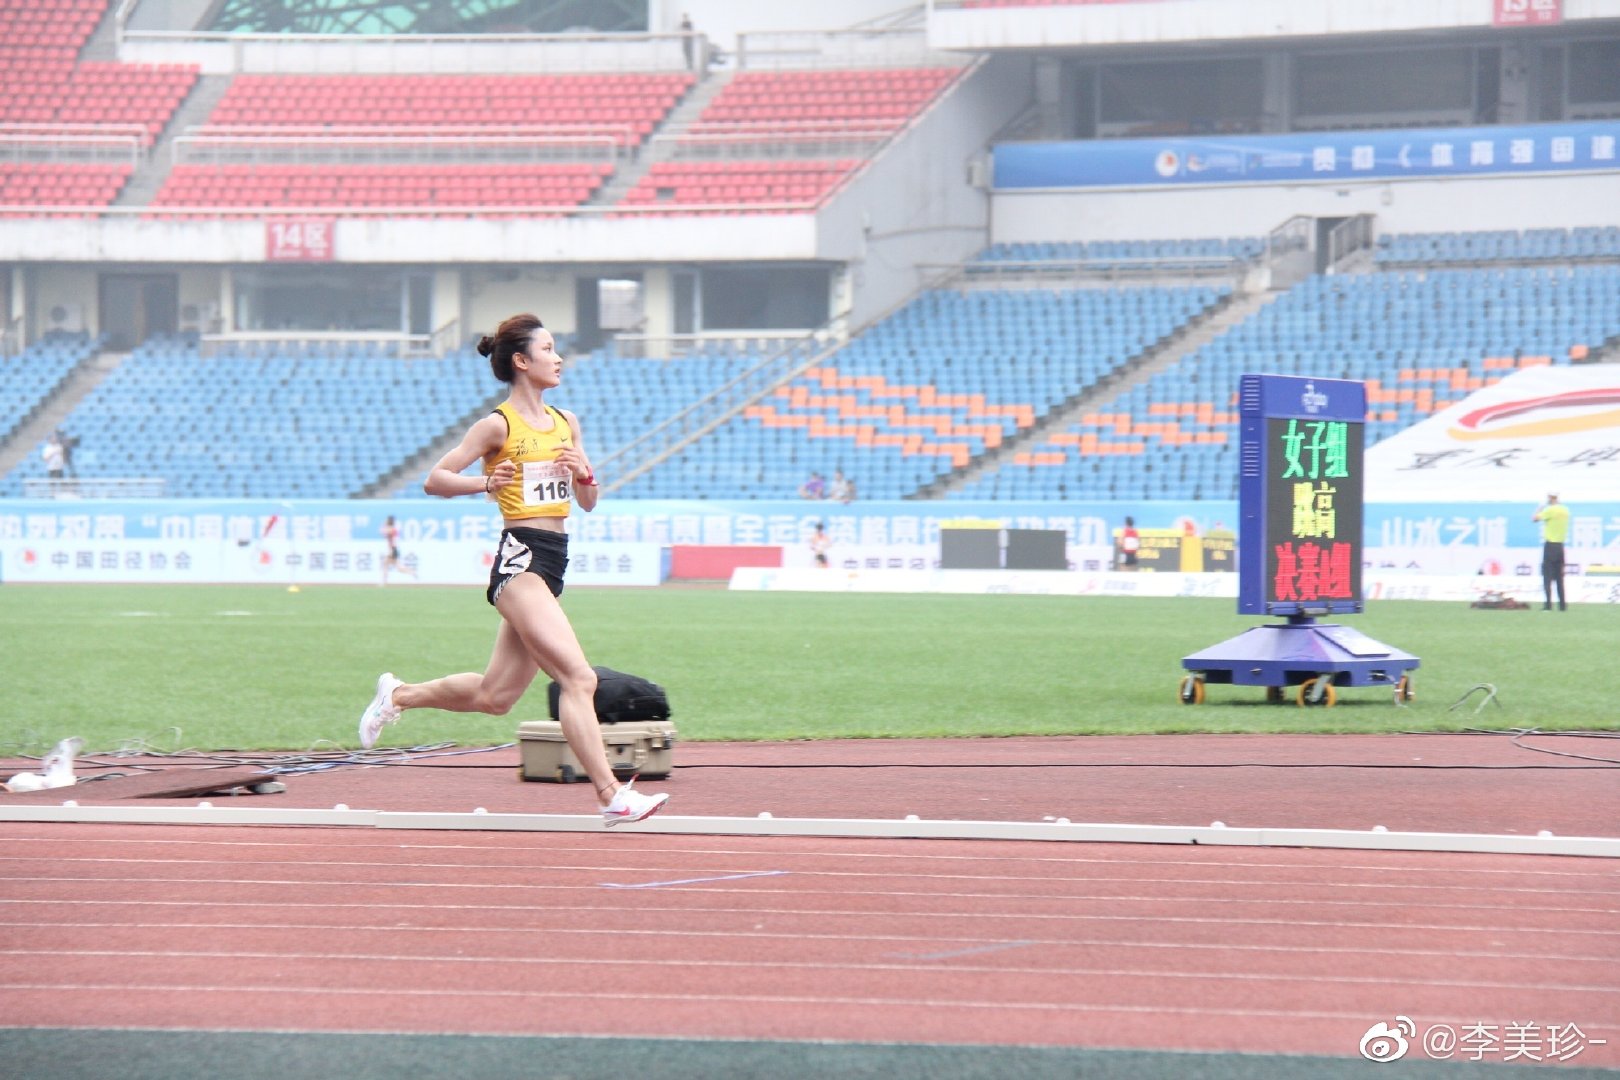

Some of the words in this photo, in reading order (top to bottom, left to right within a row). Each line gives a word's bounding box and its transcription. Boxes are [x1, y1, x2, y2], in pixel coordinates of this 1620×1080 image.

[271, 223, 328, 248] 14区
[1281, 419, 1349, 478] 女子组
[533, 480, 570, 501] 116
[1292, 481, 1336, 538] 跳高
[1380, 516, 1508, 547] 山水之城
[51, 551, 192, 570] 中国田径协会
[1274, 542, 1352, 601] 决赛组
